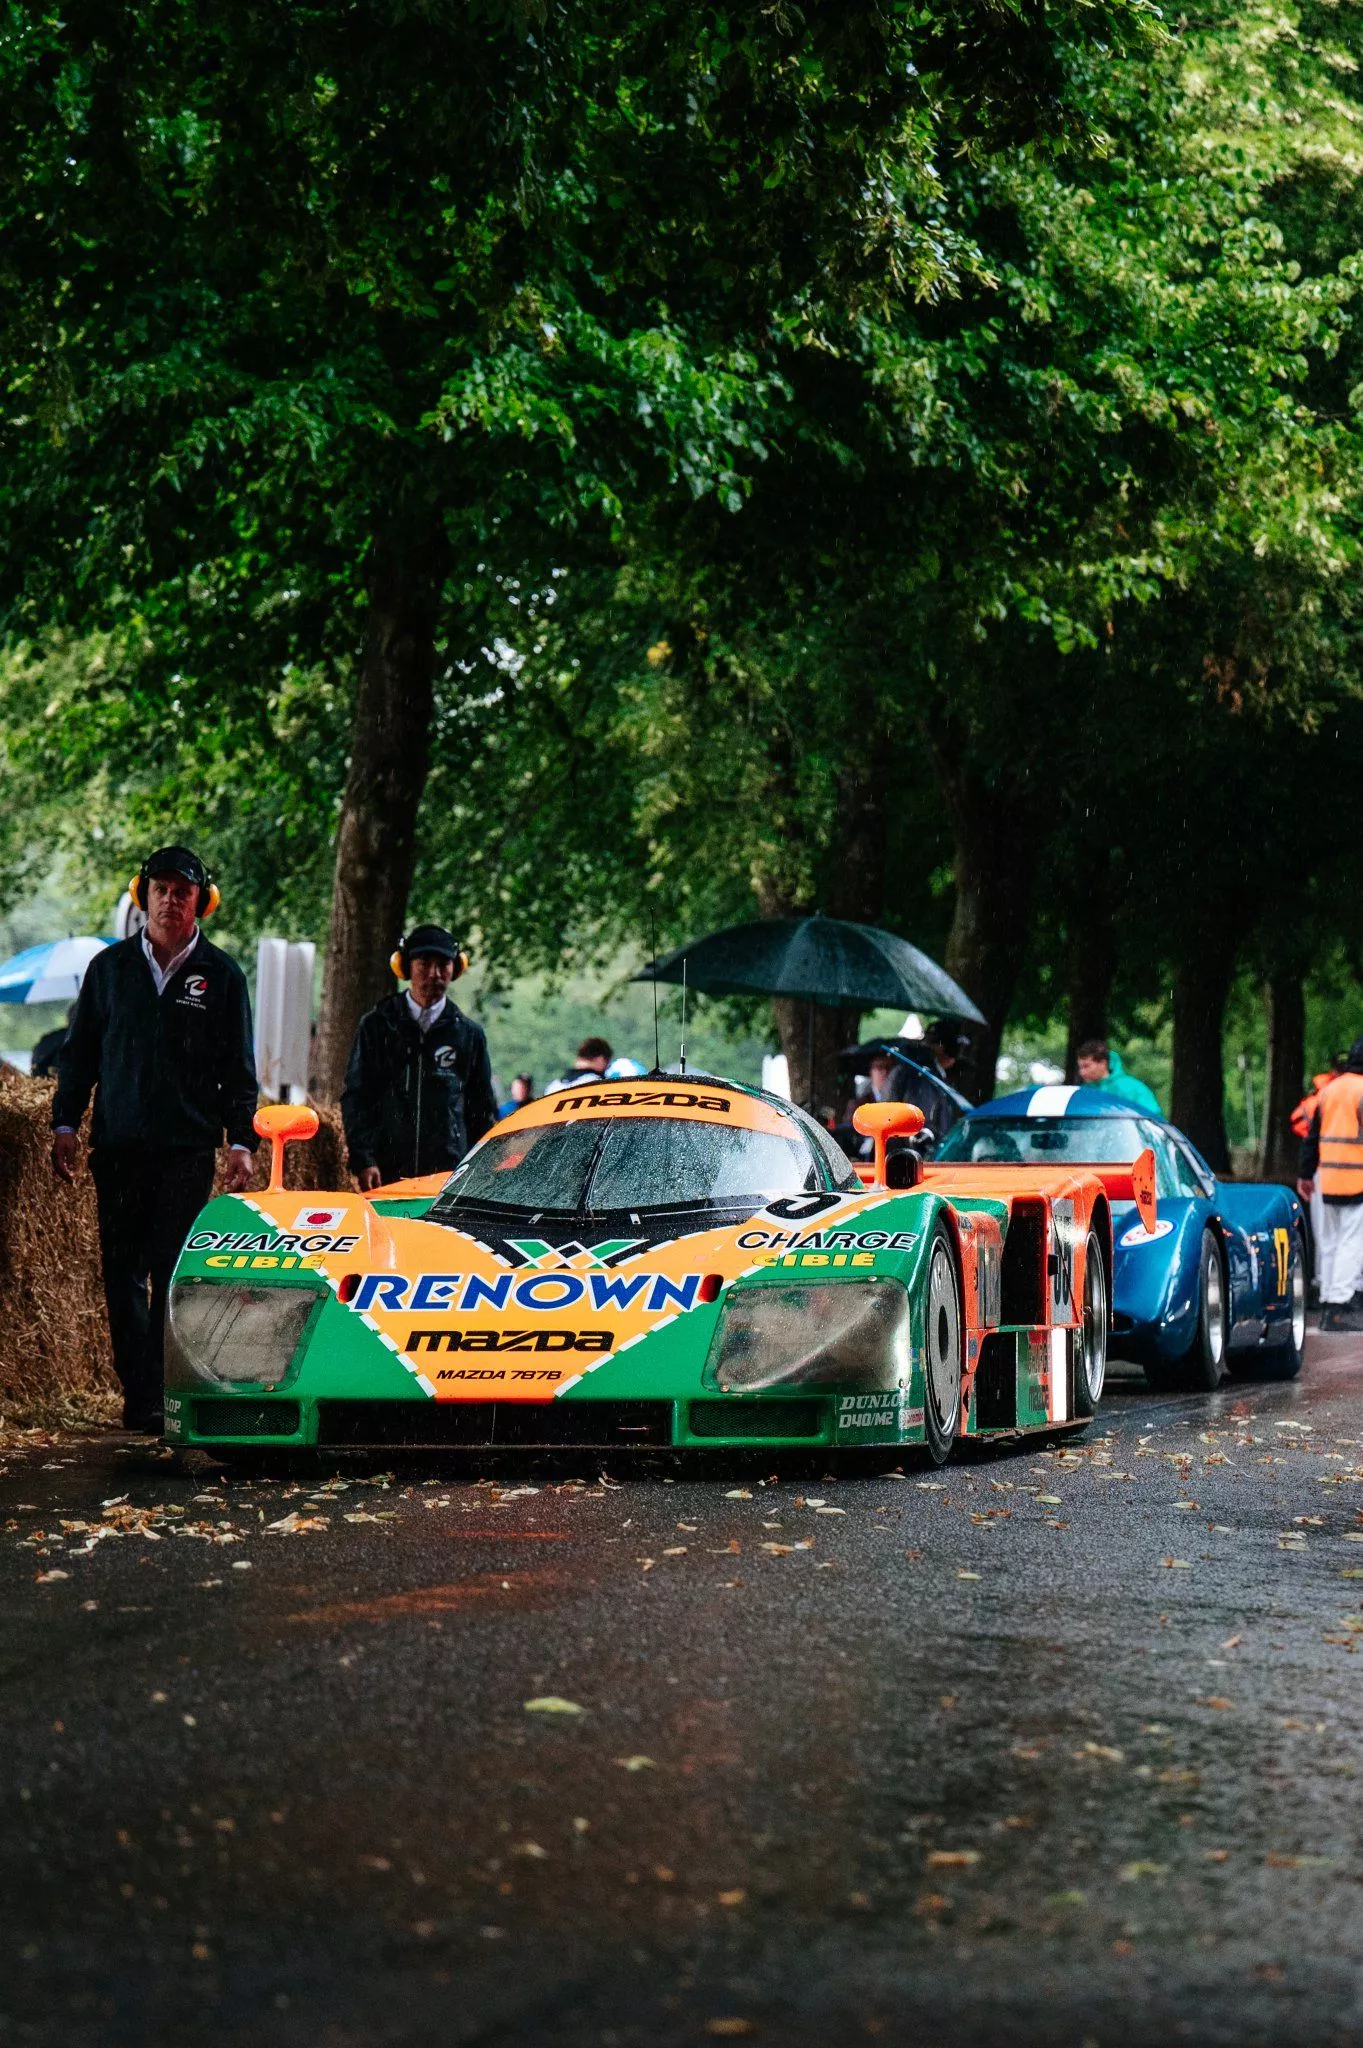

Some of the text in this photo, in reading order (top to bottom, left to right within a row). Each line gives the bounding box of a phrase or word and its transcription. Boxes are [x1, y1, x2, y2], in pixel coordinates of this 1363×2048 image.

[184, 1230, 363, 1253] CHARGE
[736, 1231, 919, 1252] CHARGE
[1274, 1228, 1290, 1297] 17
[350, 1273, 704, 1312] RENOWN
[404, 1330, 614, 1352] mazda
[436, 1370, 563, 1381] MAZDA 787B
[839, 1411, 894, 1429] D40/M2
